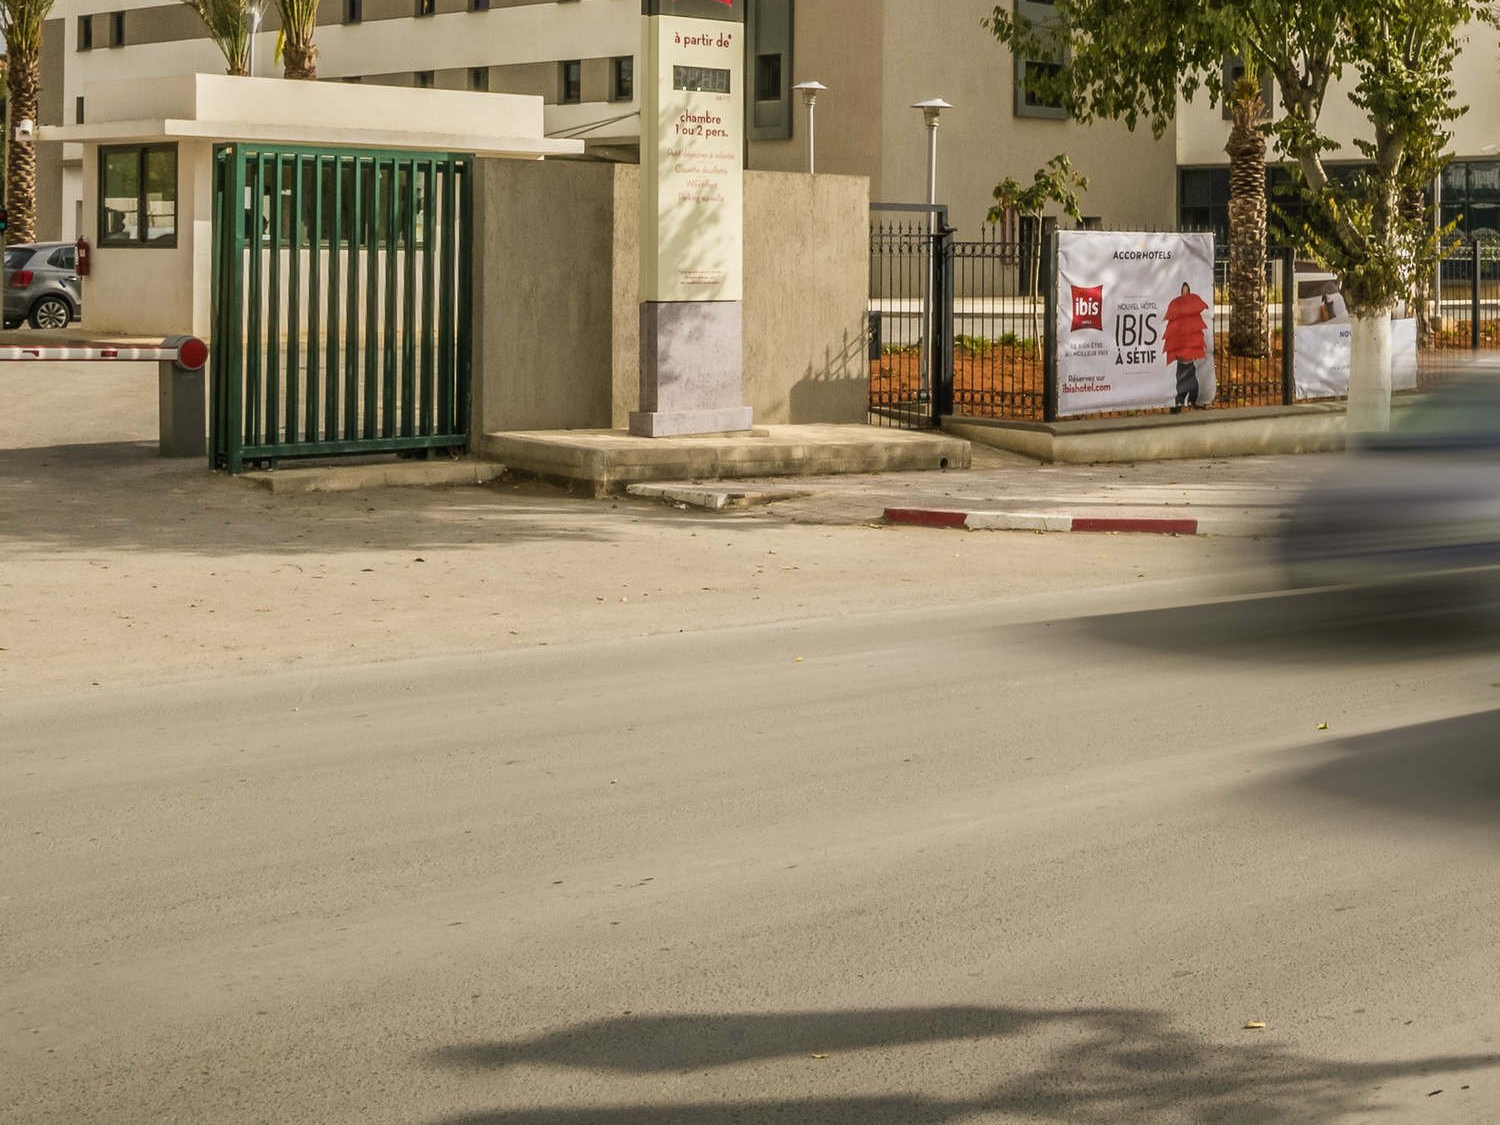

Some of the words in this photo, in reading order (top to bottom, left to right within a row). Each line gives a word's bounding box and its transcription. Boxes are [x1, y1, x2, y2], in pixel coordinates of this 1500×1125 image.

[674, 31, 681, 44] à
[684, 33, 713, 48] partir
[680, 109, 721, 125] chambre
[682, 126, 695, 136] ou
[697, 125, 703, 136] 2
[705, 127, 729, 139] pers.
[1112, 250, 1172, 260] ACCORHOTELS
[1075, 297, 1099, 316] ibis
[1115, 313, 1158, 347] IBIS
[1115, 348, 1124, 365] À
[1126, 346, 1157, 364] SÉTIF
[1062, 383, 1111, 394] ibishotel.com
